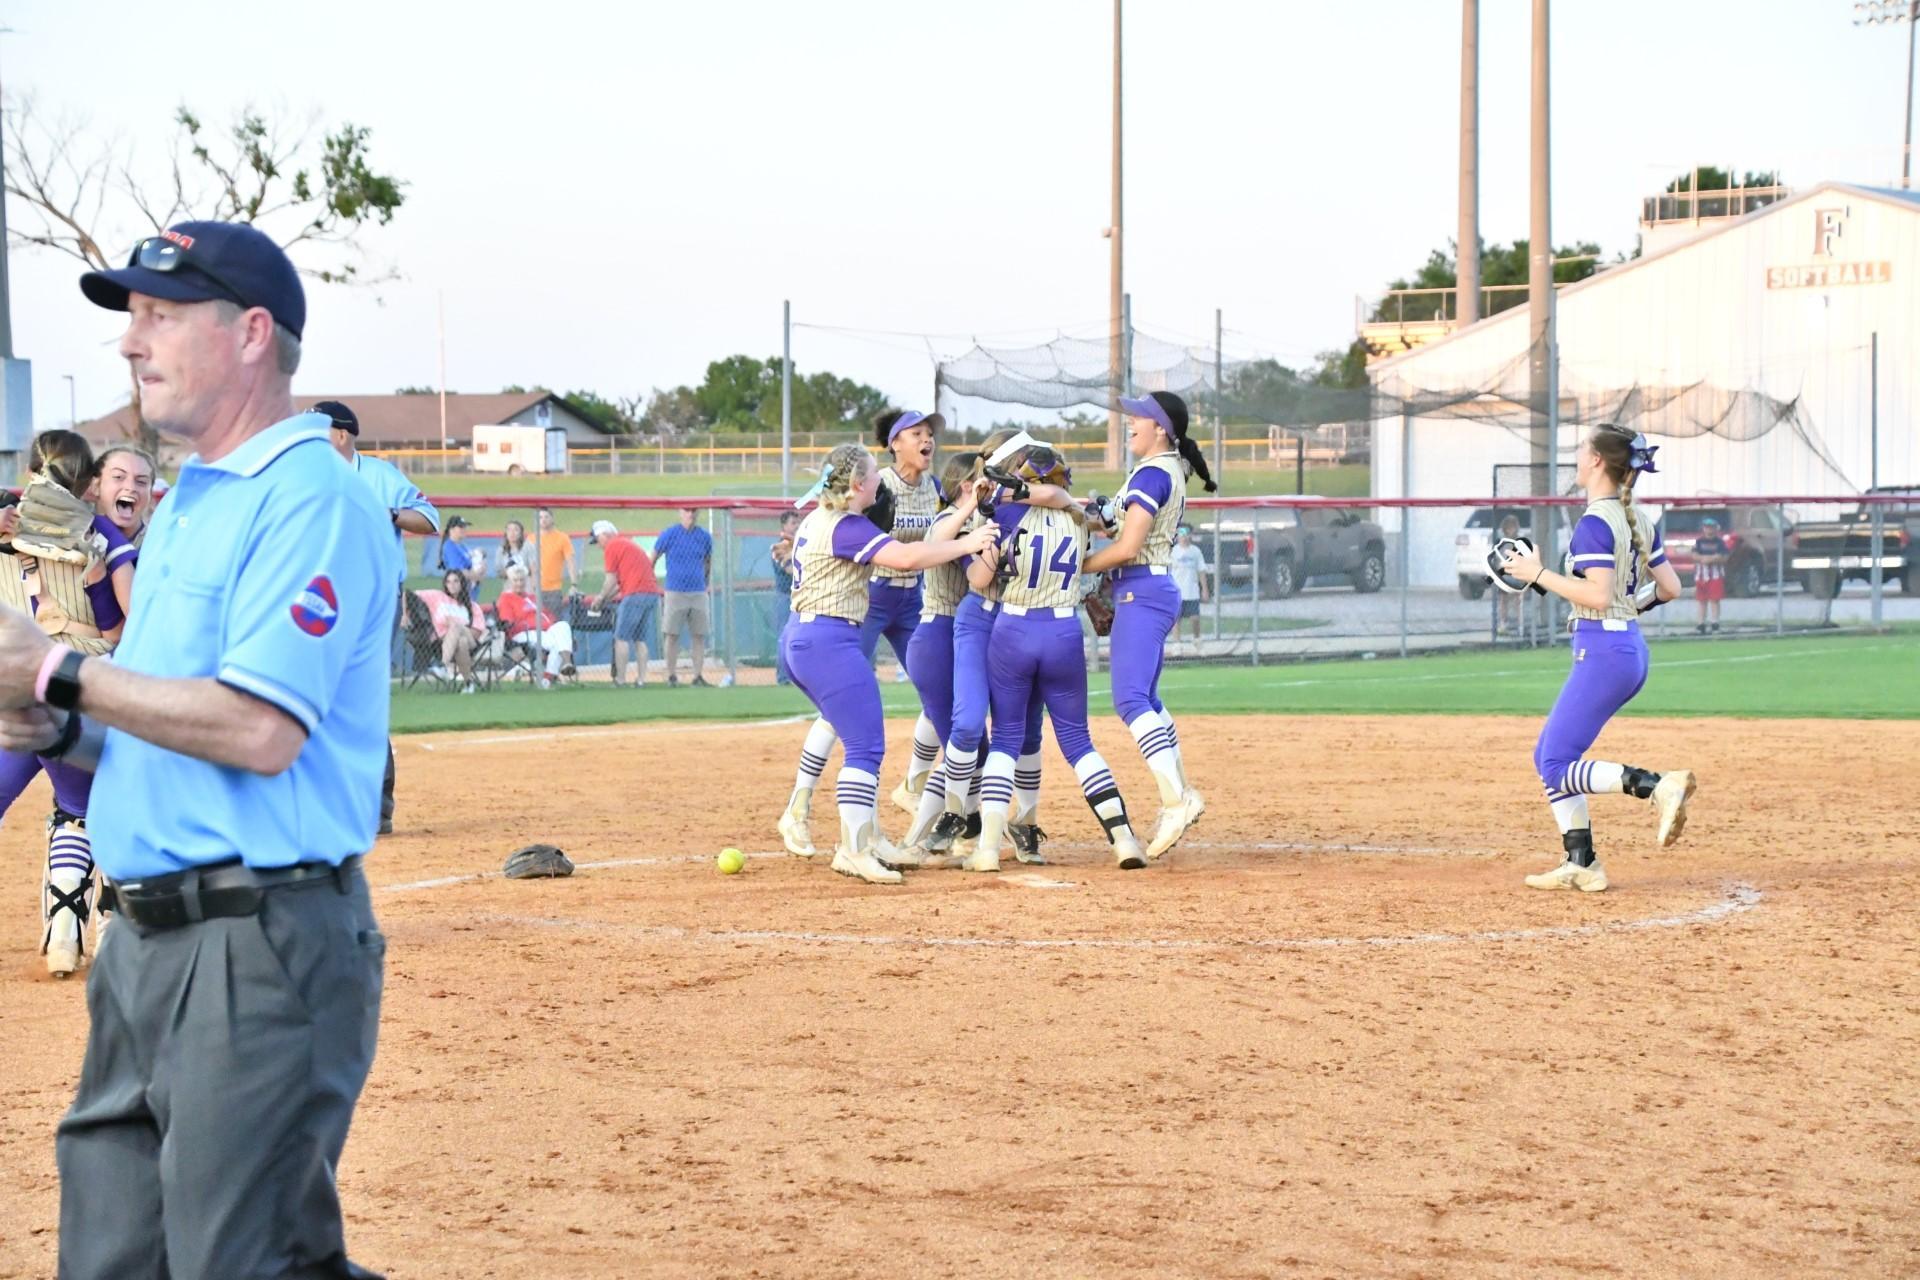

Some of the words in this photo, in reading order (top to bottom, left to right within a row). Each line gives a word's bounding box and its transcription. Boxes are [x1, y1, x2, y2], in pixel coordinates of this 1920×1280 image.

[1813, 206, 1850, 256] F
[1769, 262, 1889, 288] SOFTBALL
[1027, 534, 1078, 591] 14
